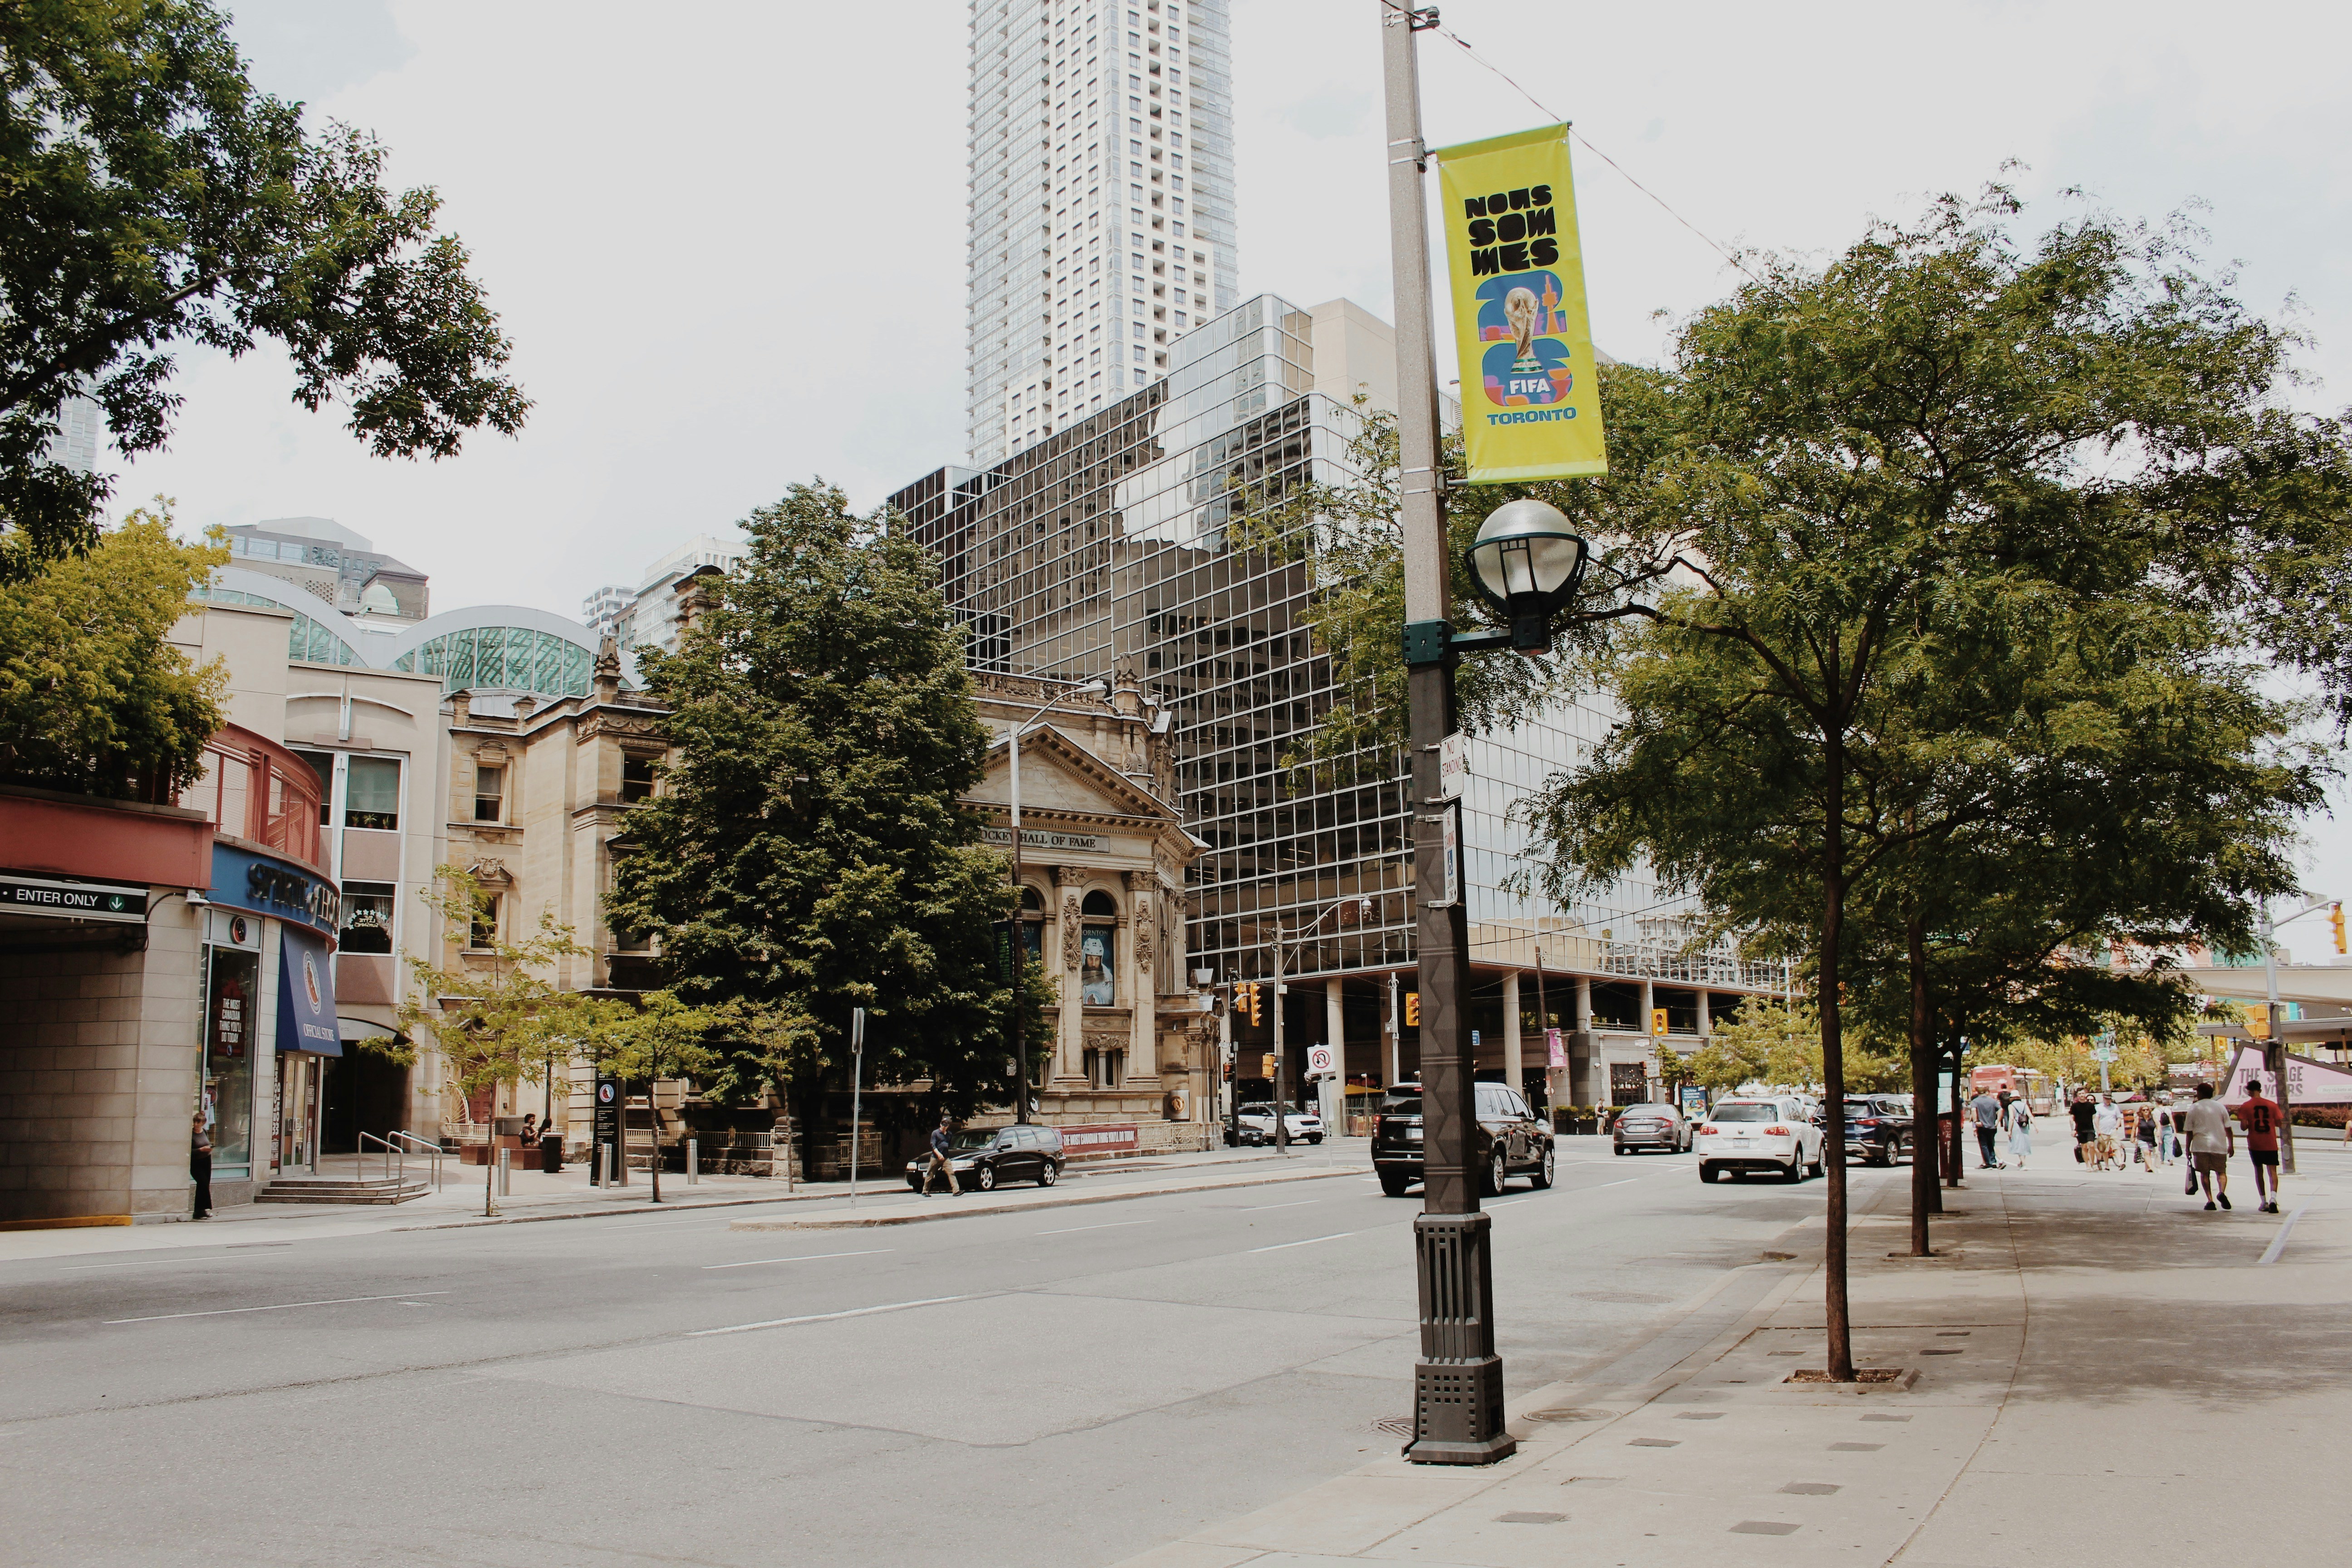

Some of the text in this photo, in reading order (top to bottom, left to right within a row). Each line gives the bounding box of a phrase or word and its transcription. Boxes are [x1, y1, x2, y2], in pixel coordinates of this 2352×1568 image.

[1465, 185, 1552, 219] NOUS
[1468, 206, 1556, 243] SOM
[1470, 238, 1559, 276] MES
[1509, 378, 1551, 394] FIFA
[1487, 407, 1577, 425] TORONTO
[1447, 740, 1455, 756] NO
[1442, 756, 1461, 778] STANDING
[980, 829, 1096, 848] OCKE HALL OF FAME
[16, 888, 98, 906] ENTER ONLY
[230, 999, 241, 1010] MOST
[222, 1009, 240, 1021] CANADIAN
[219, 1020, 230, 1031] THING
[303, 1023, 335, 1042] OFFICIAL STORE
[221, 1032, 239, 1043] DO TODAY
[2239, 1066, 2303, 1083] THE SGE
[2264, 1083, 2303, 1098] YORS
[1070, 1133, 1081, 1146] MOST
[1098, 1132, 1109, 1144] THING
[1119, 1131, 1125, 1142] DO
[1124, 1130, 1135, 1142] TODAY
